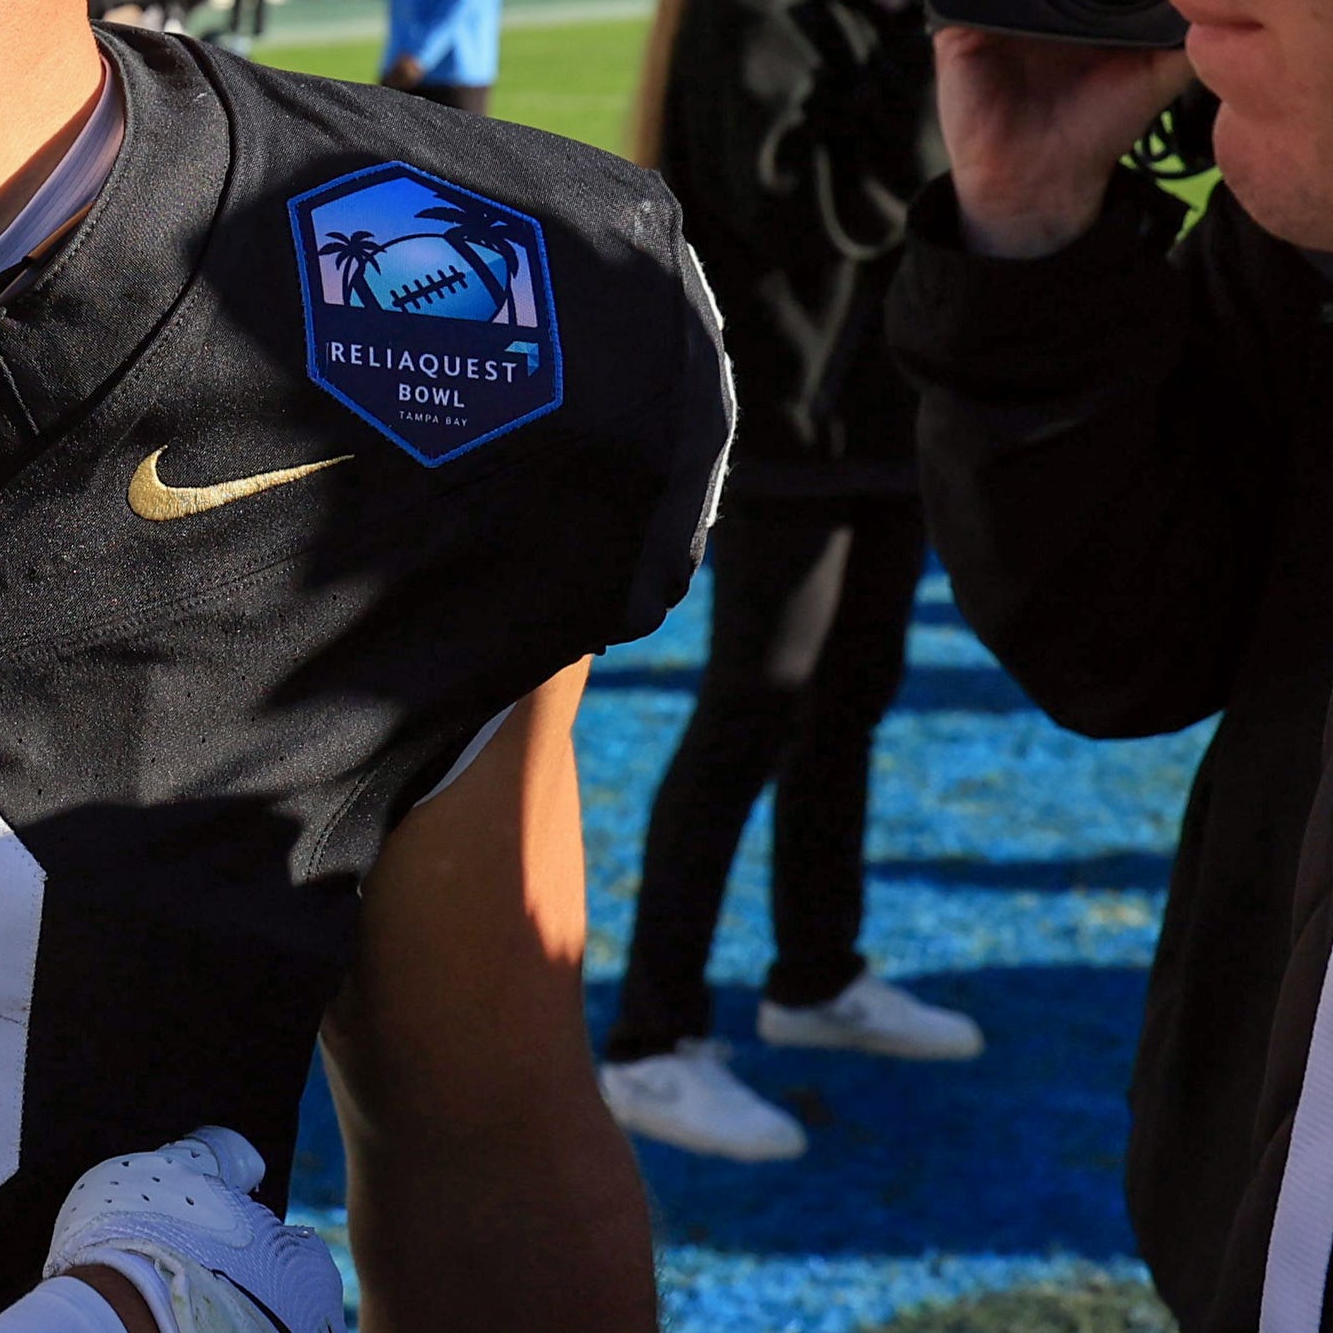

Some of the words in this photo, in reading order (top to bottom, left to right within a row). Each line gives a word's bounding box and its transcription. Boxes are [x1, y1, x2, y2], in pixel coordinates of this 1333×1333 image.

[330, 341, 518, 384] RELIAQUEST
[397, 382, 466, 409] BOWL
[398, 410, 440, 425] TAMPA
[444, 414, 469, 427] BAY
